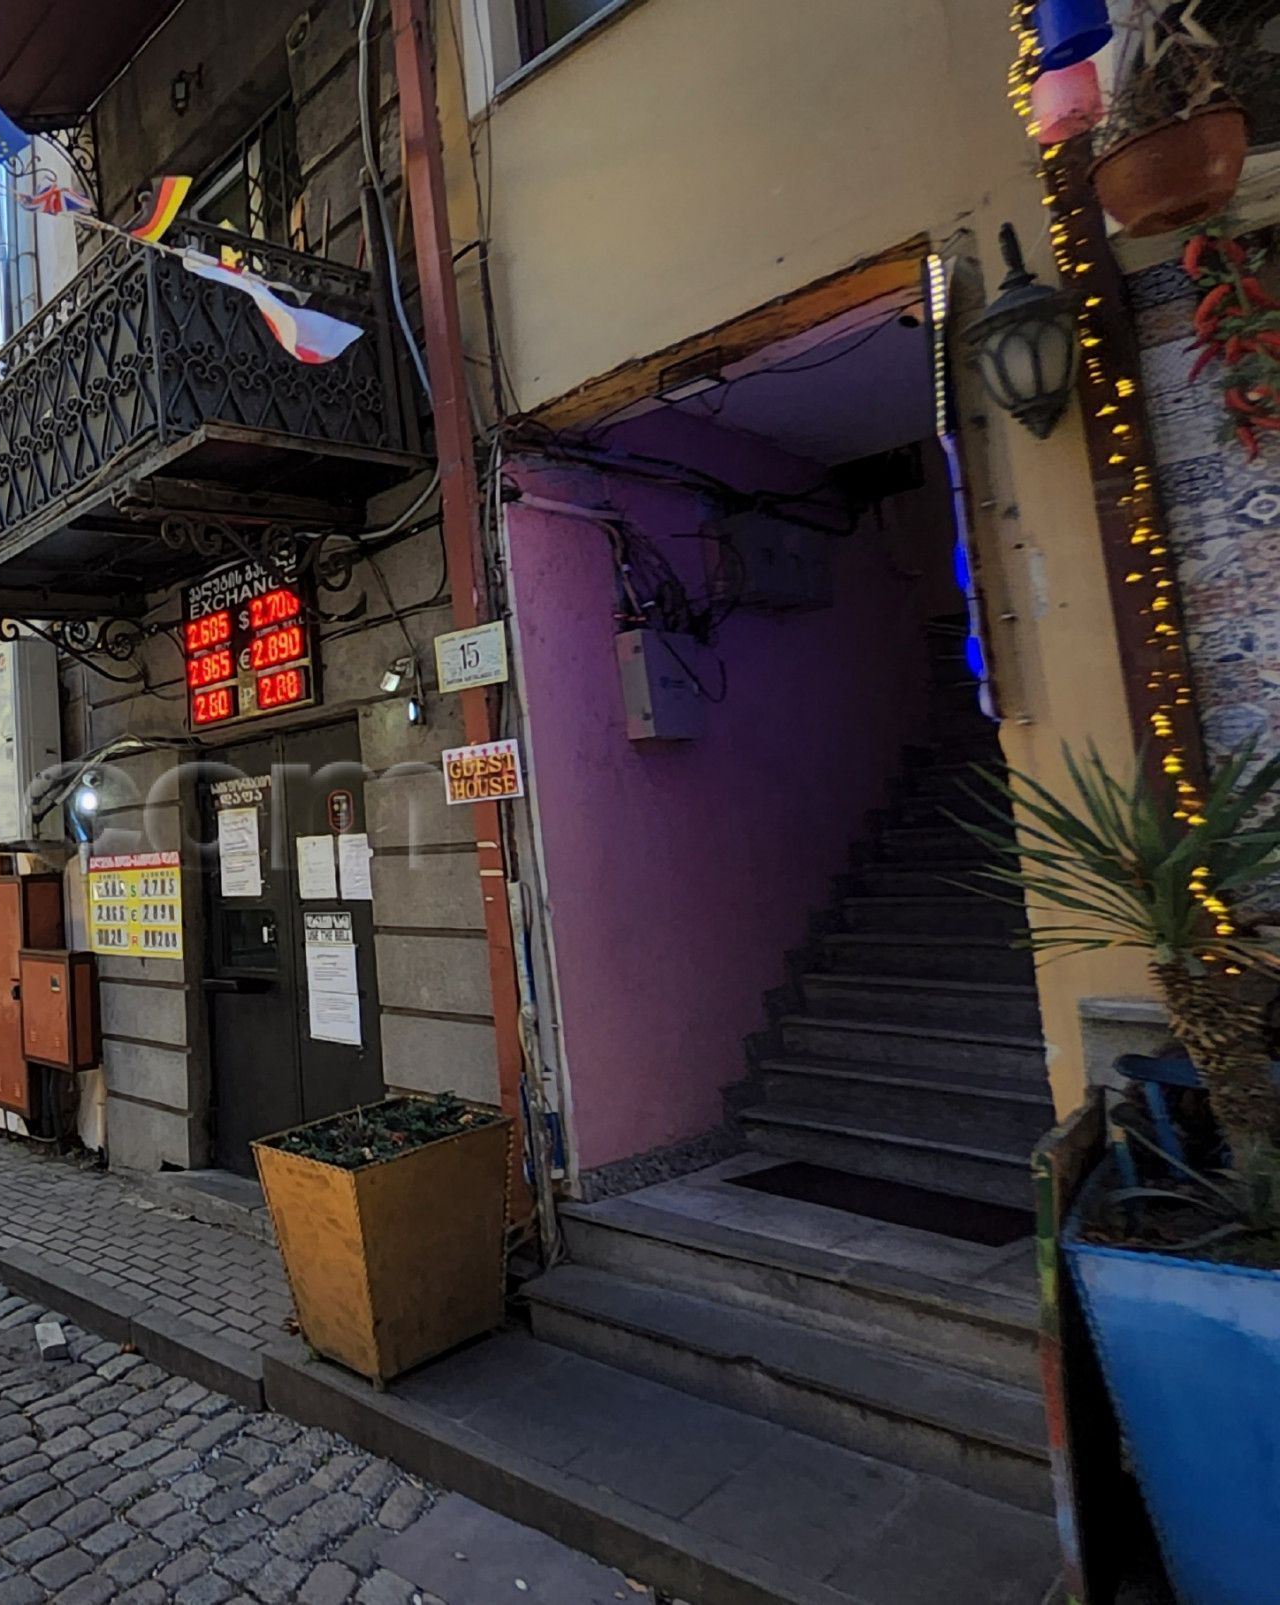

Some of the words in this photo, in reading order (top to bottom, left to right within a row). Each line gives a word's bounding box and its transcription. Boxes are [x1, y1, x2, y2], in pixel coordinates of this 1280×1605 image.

[460, 641, 480, 670] 15
[450, 752, 515, 779] GUEST
[453, 773, 518, 800] HOUSE
